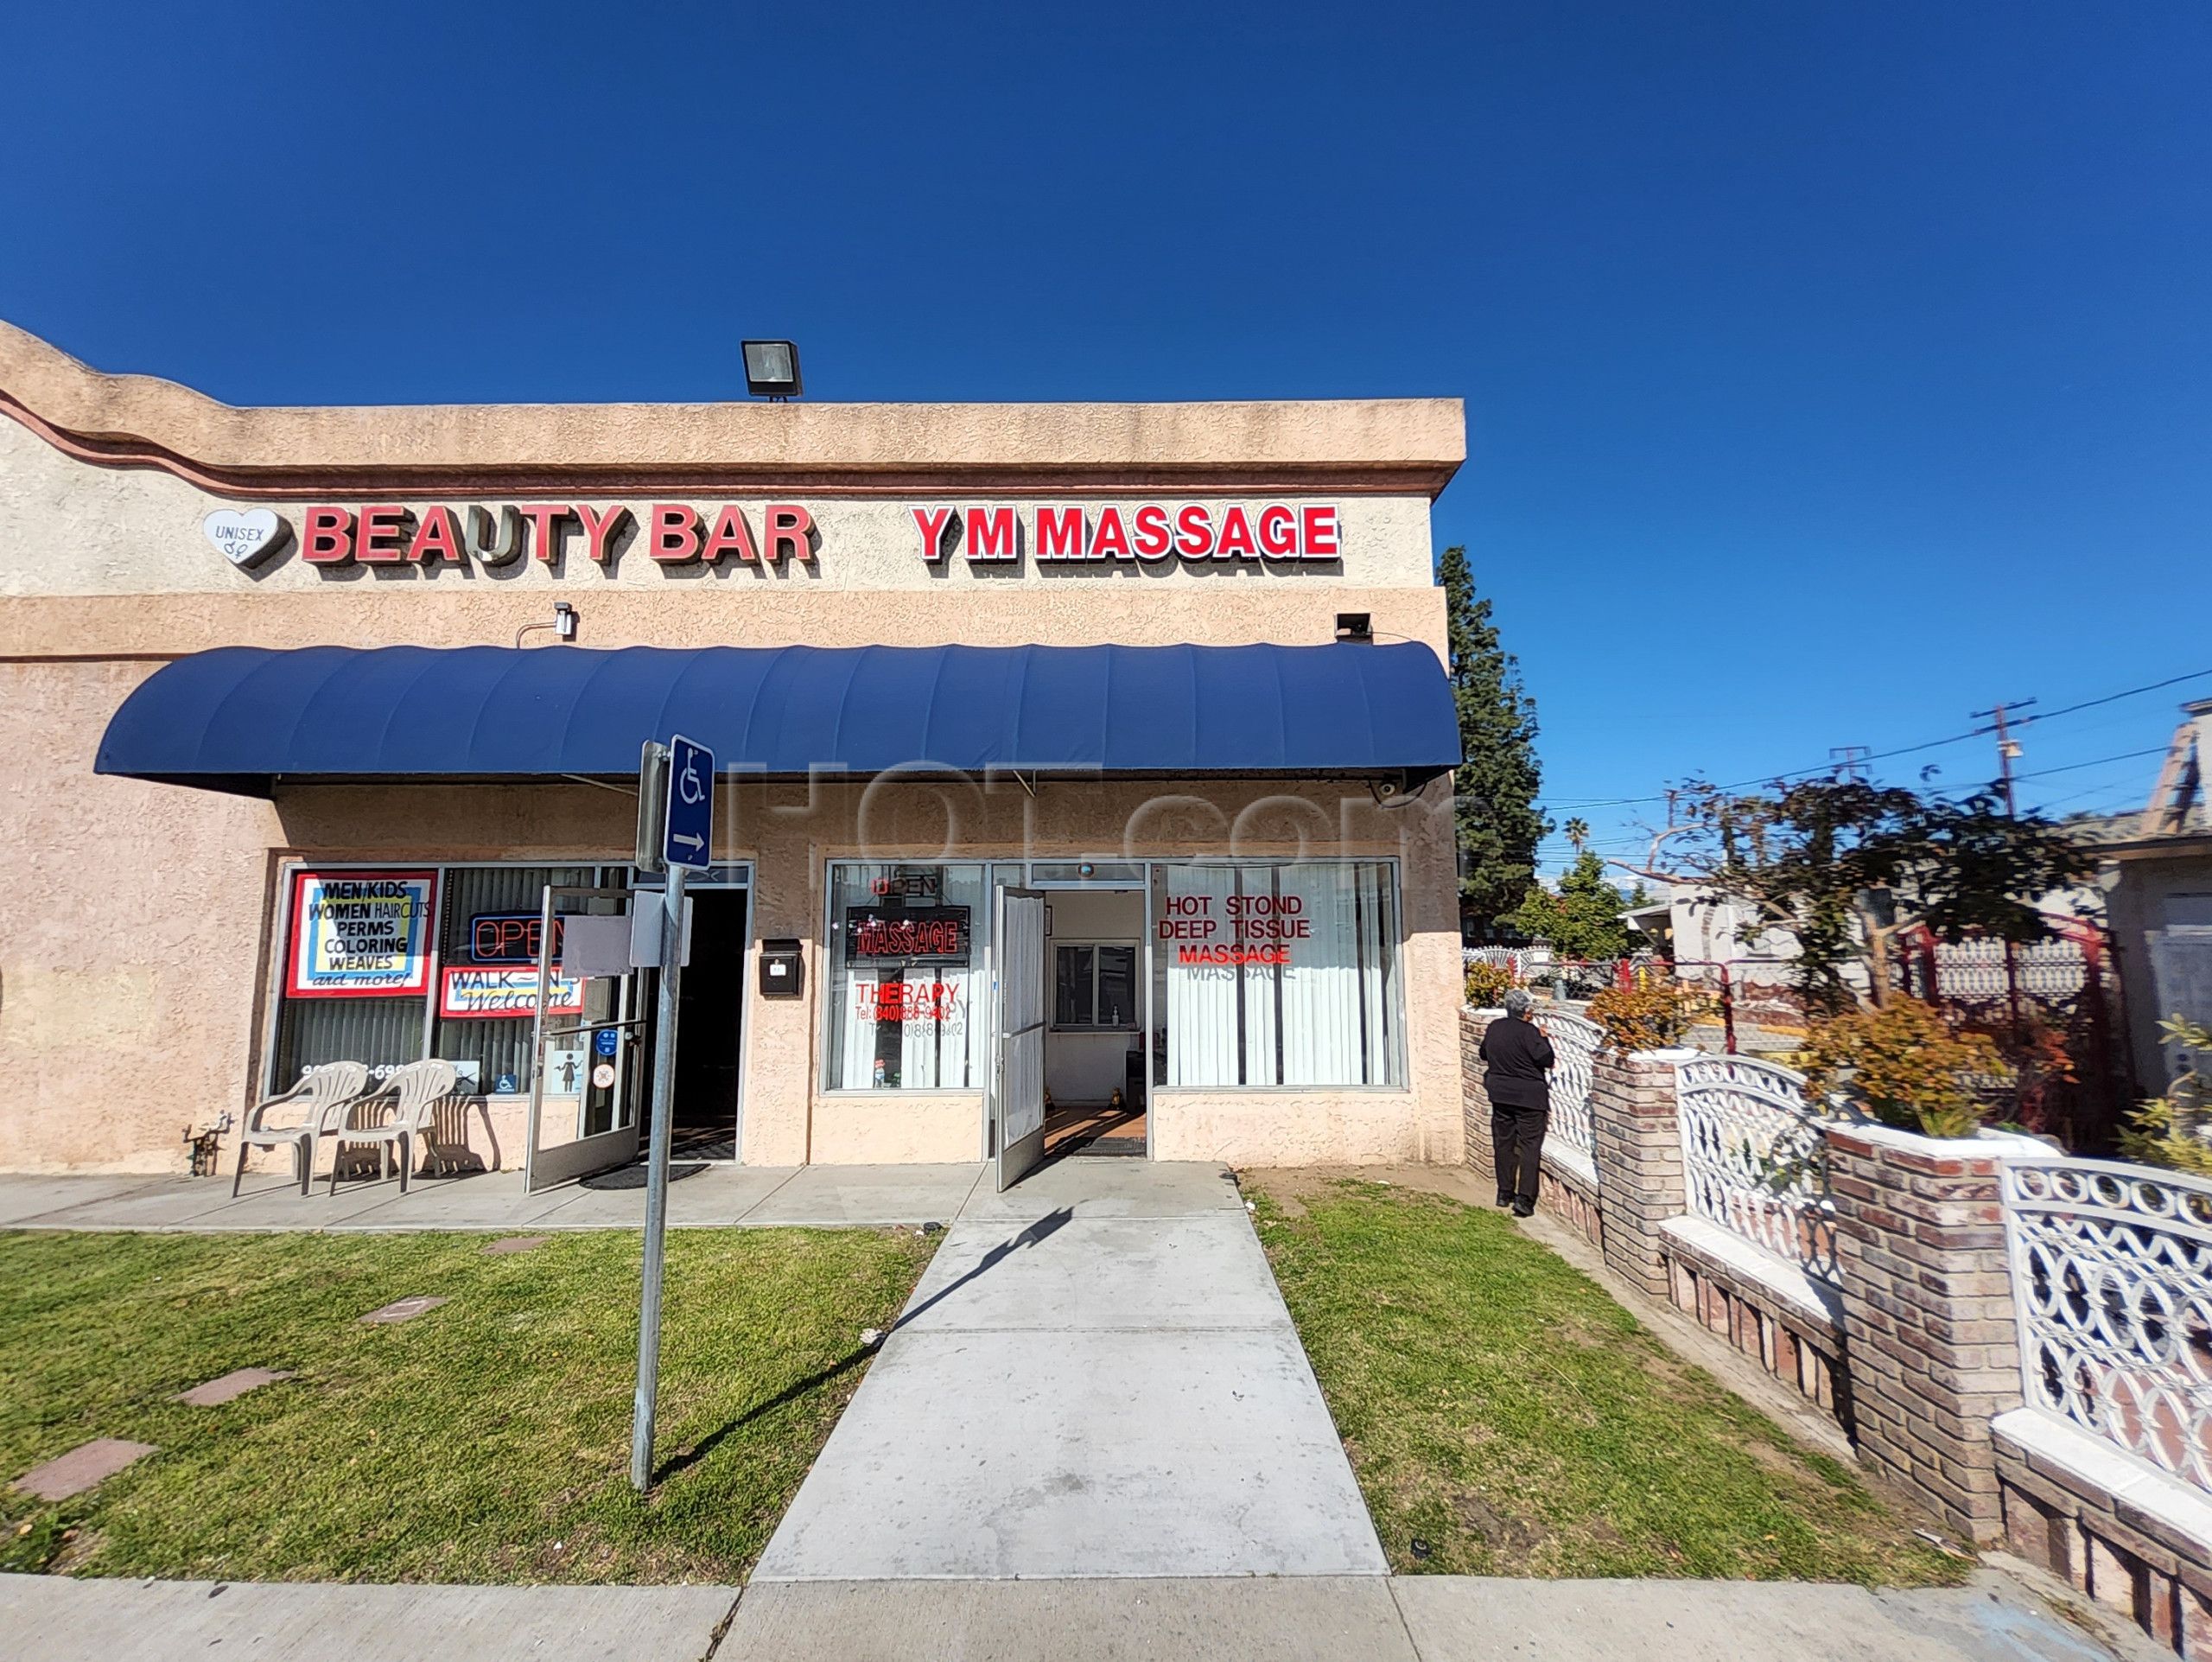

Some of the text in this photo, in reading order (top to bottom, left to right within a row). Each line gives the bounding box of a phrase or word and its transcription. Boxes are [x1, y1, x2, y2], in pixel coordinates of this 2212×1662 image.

[215, 525, 264, 541] UNISEX
[302, 504, 811, 562] BEAUTY BAR
[1034, 503, 1341, 562] MASSAGE
[323, 881, 408, 901] MEN/KIDS
[870, 876, 938, 895] OPEN
[308, 901, 431, 920] WOMEN HAIRCUTS
[1166, 896, 1302, 915] HOT STOND
[337, 920, 394, 936] PERMS
[857, 920, 958, 954] MASSAGE
[1159, 920, 1310, 939] DEEP TISSUE
[324, 937, 409, 954] COLORING
[1179, 944, 1290, 964] MASSAGE
[329, 956, 393, 971] WEAVES
[312, 973, 347, 986] and
[855, 982, 960, 1003] THERAPY
